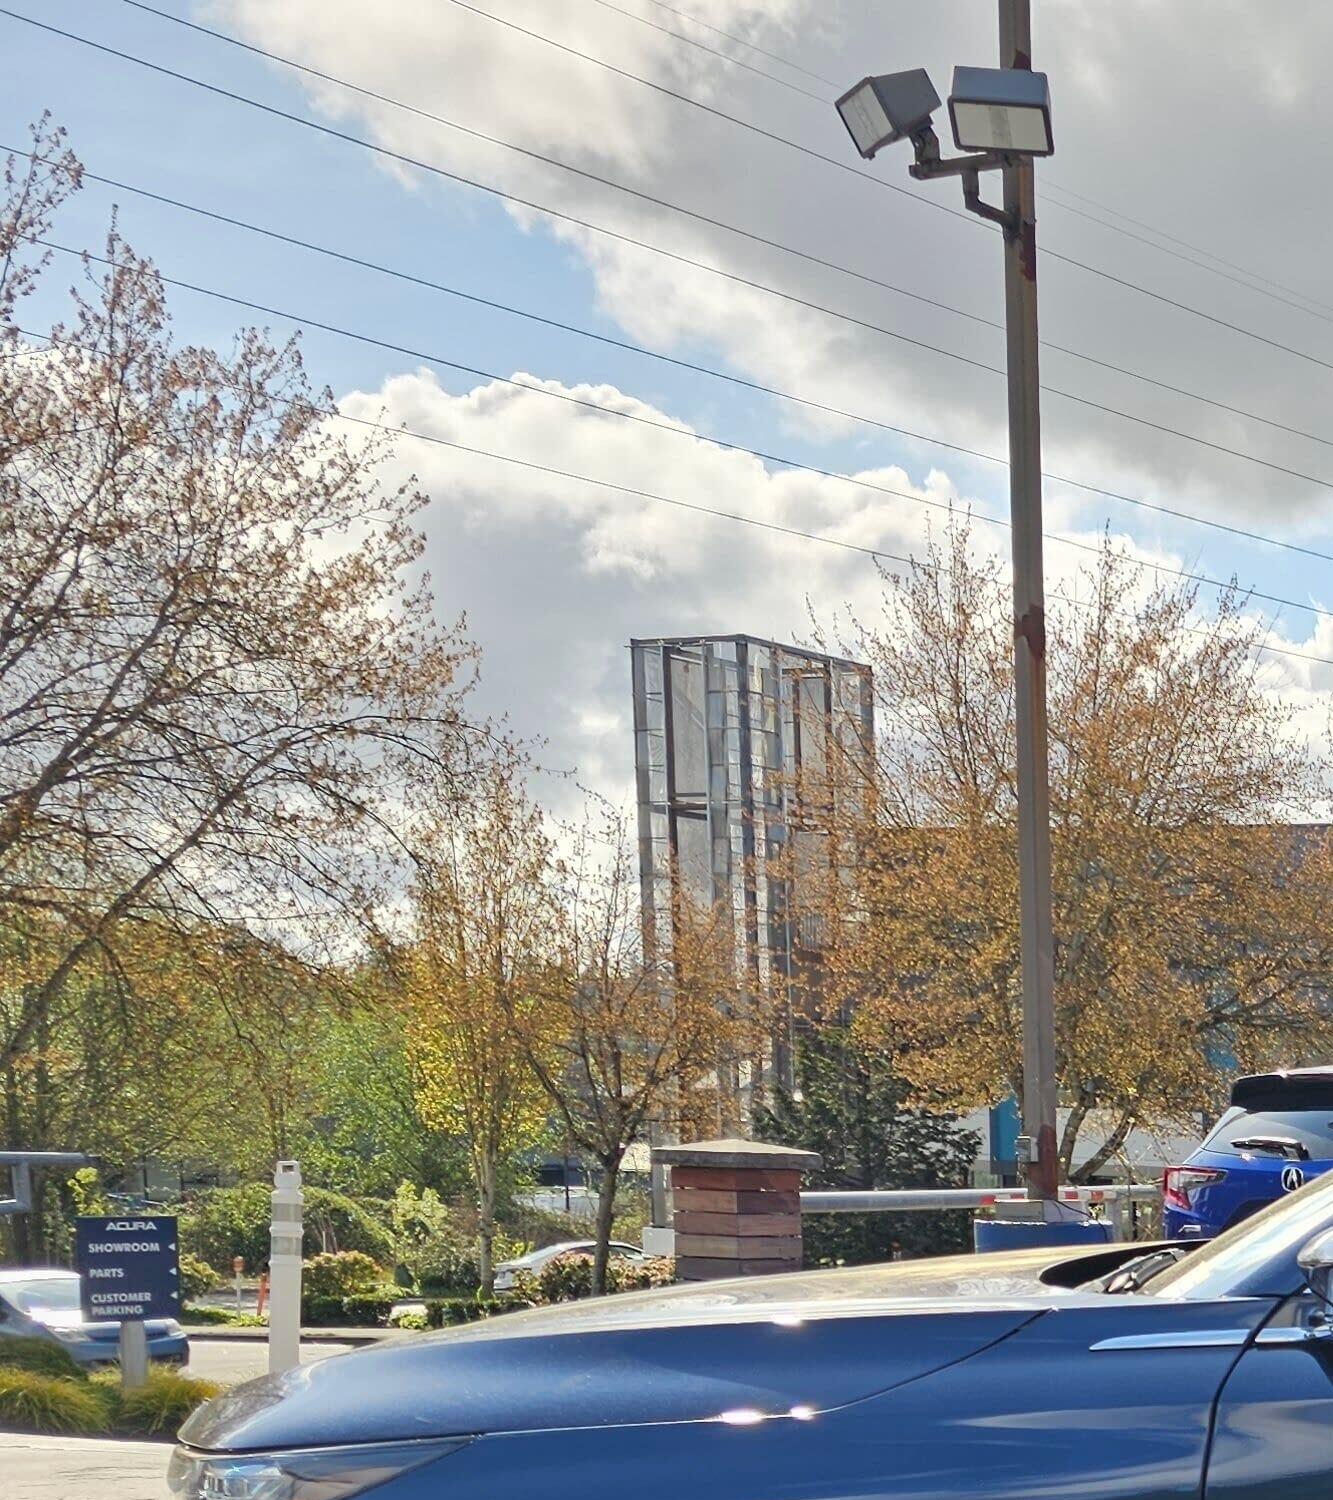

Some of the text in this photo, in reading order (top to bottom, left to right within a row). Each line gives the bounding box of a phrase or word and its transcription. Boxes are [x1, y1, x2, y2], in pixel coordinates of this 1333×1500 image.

[105, 1221, 157, 1231] ACURA
[88, 1242, 160, 1253] SHOWROOM
[89, 1268, 124, 1278] PARTS
[90, 1292, 152, 1303] CUSTOMER
[91, 1305, 144, 1315] PARKING
